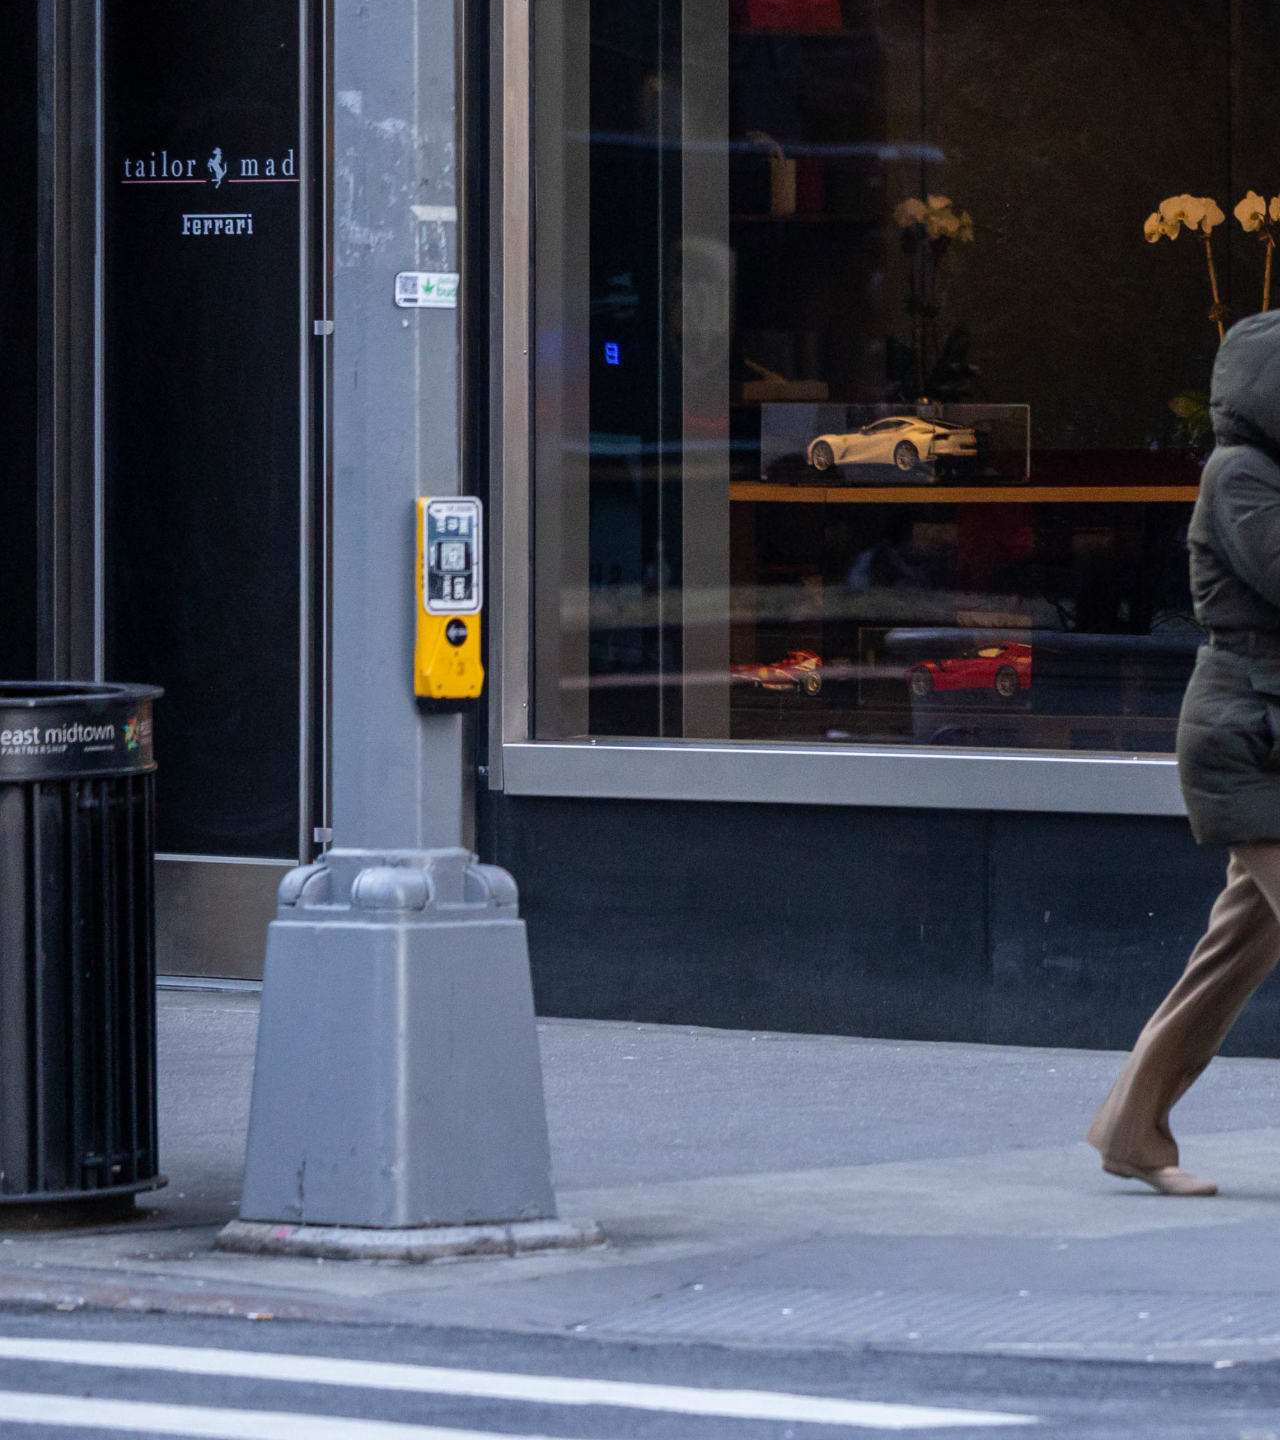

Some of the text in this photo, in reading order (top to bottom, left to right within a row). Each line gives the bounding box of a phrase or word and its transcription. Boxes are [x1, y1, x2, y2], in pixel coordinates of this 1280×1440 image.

[124, 148, 296, 177] tailor mad
[182, 213, 254, 235] Ferrari
[0, 725, 41, 746] east
[45, 722, 115, 744] midtown
